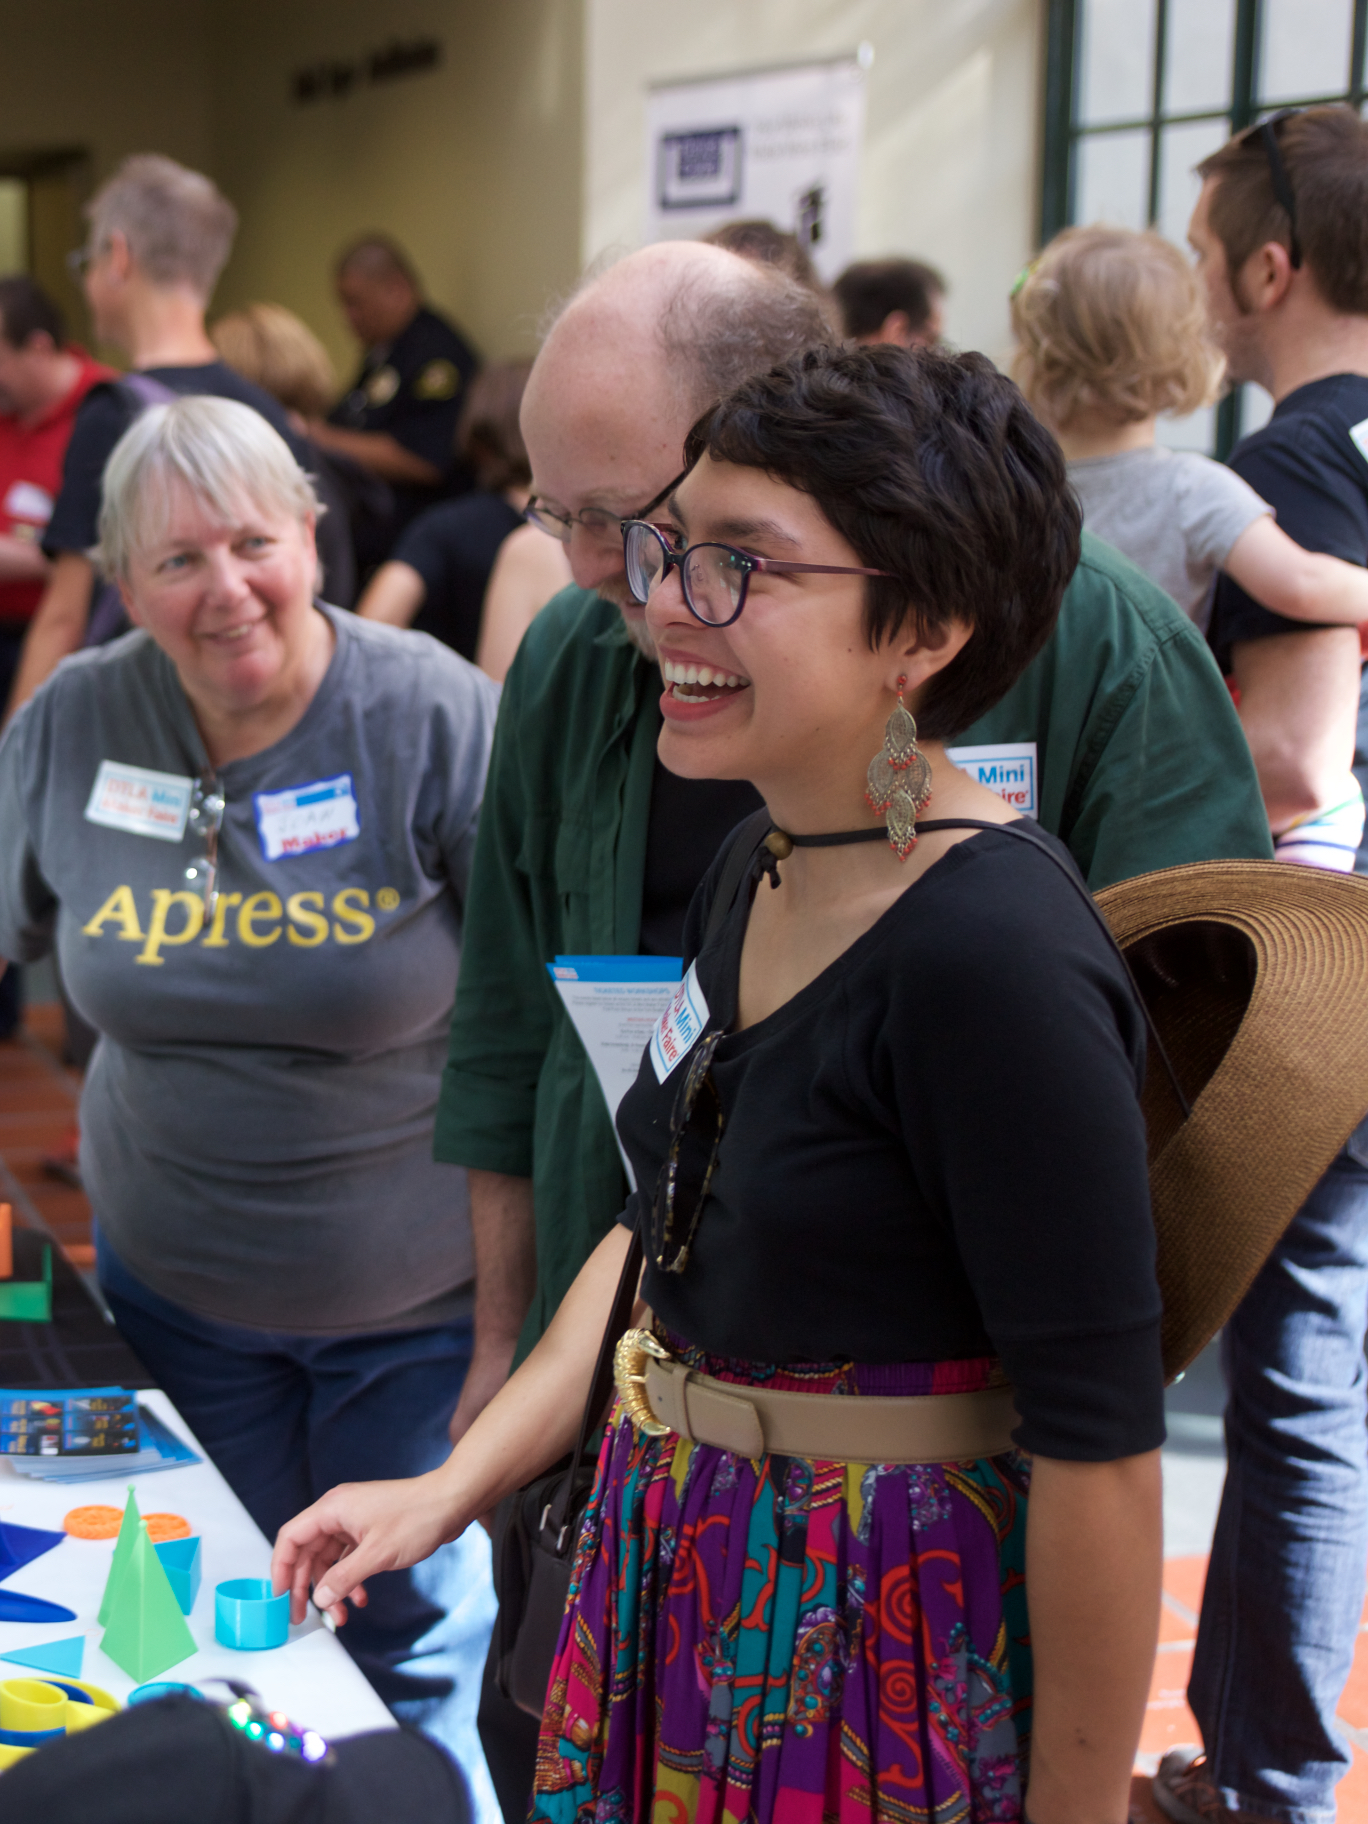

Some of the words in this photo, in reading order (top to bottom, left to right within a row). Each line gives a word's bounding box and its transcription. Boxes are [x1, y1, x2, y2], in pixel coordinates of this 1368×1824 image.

[978, 764, 1025, 784] Mini
[995, 788, 1029, 804] ire
[675, 1006, 697, 1045] Mini
[661, 1027, 680, 1062] Faire
